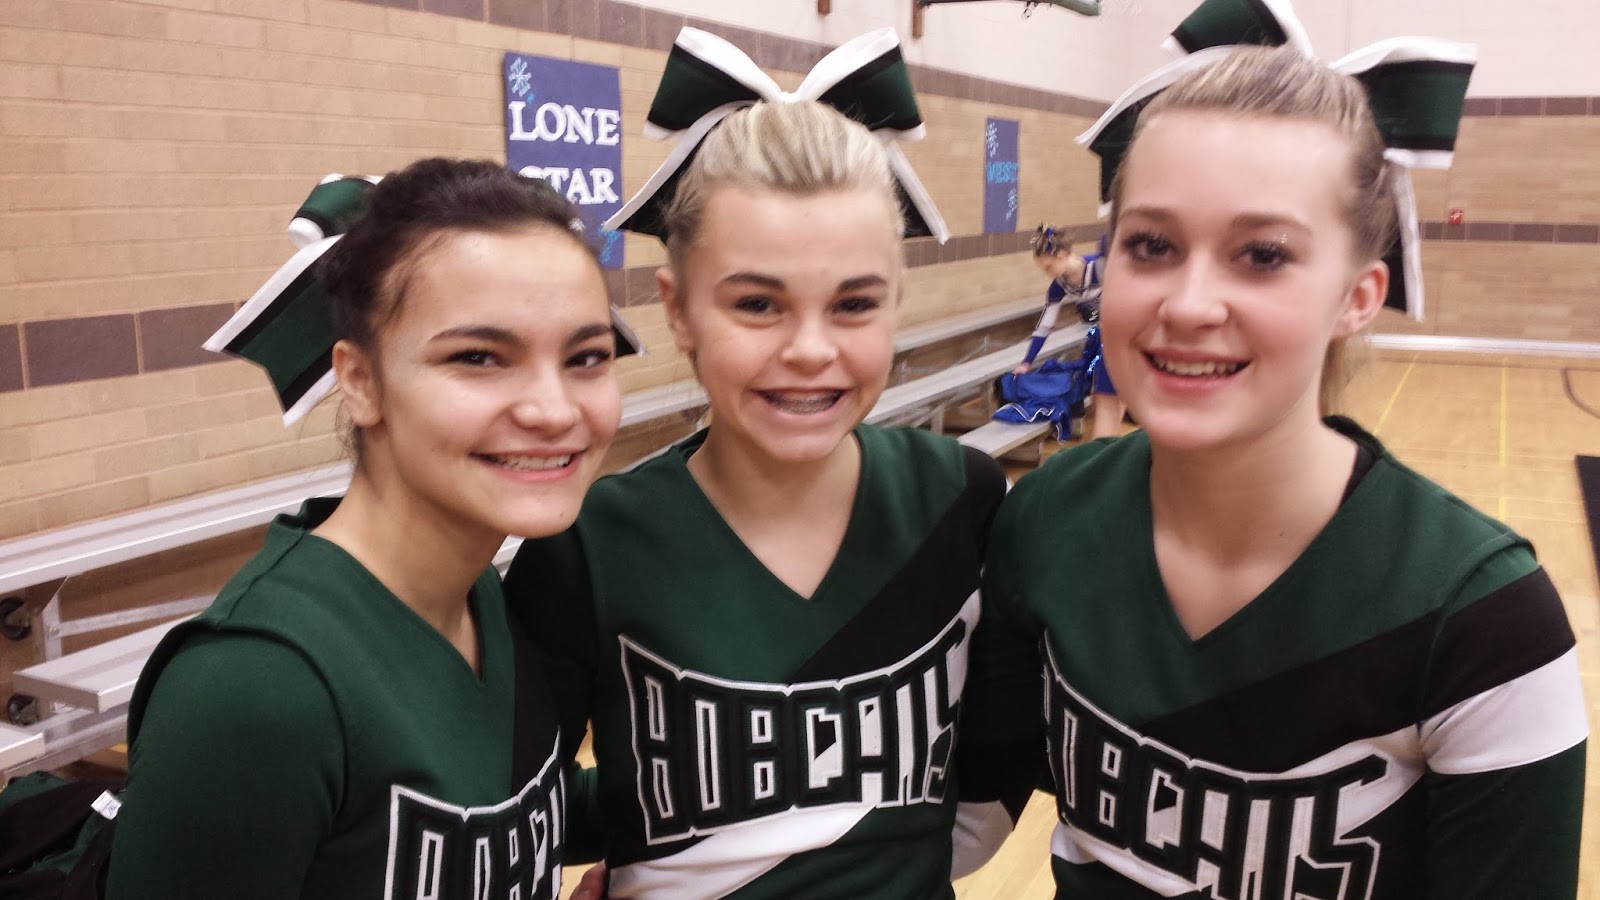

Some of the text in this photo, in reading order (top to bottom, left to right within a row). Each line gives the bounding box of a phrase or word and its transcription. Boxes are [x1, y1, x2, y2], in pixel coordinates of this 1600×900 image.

[508, 101, 620, 146] LONE
[517, 165, 619, 205] TAR
[618, 612, 969, 846] BOBCATS
